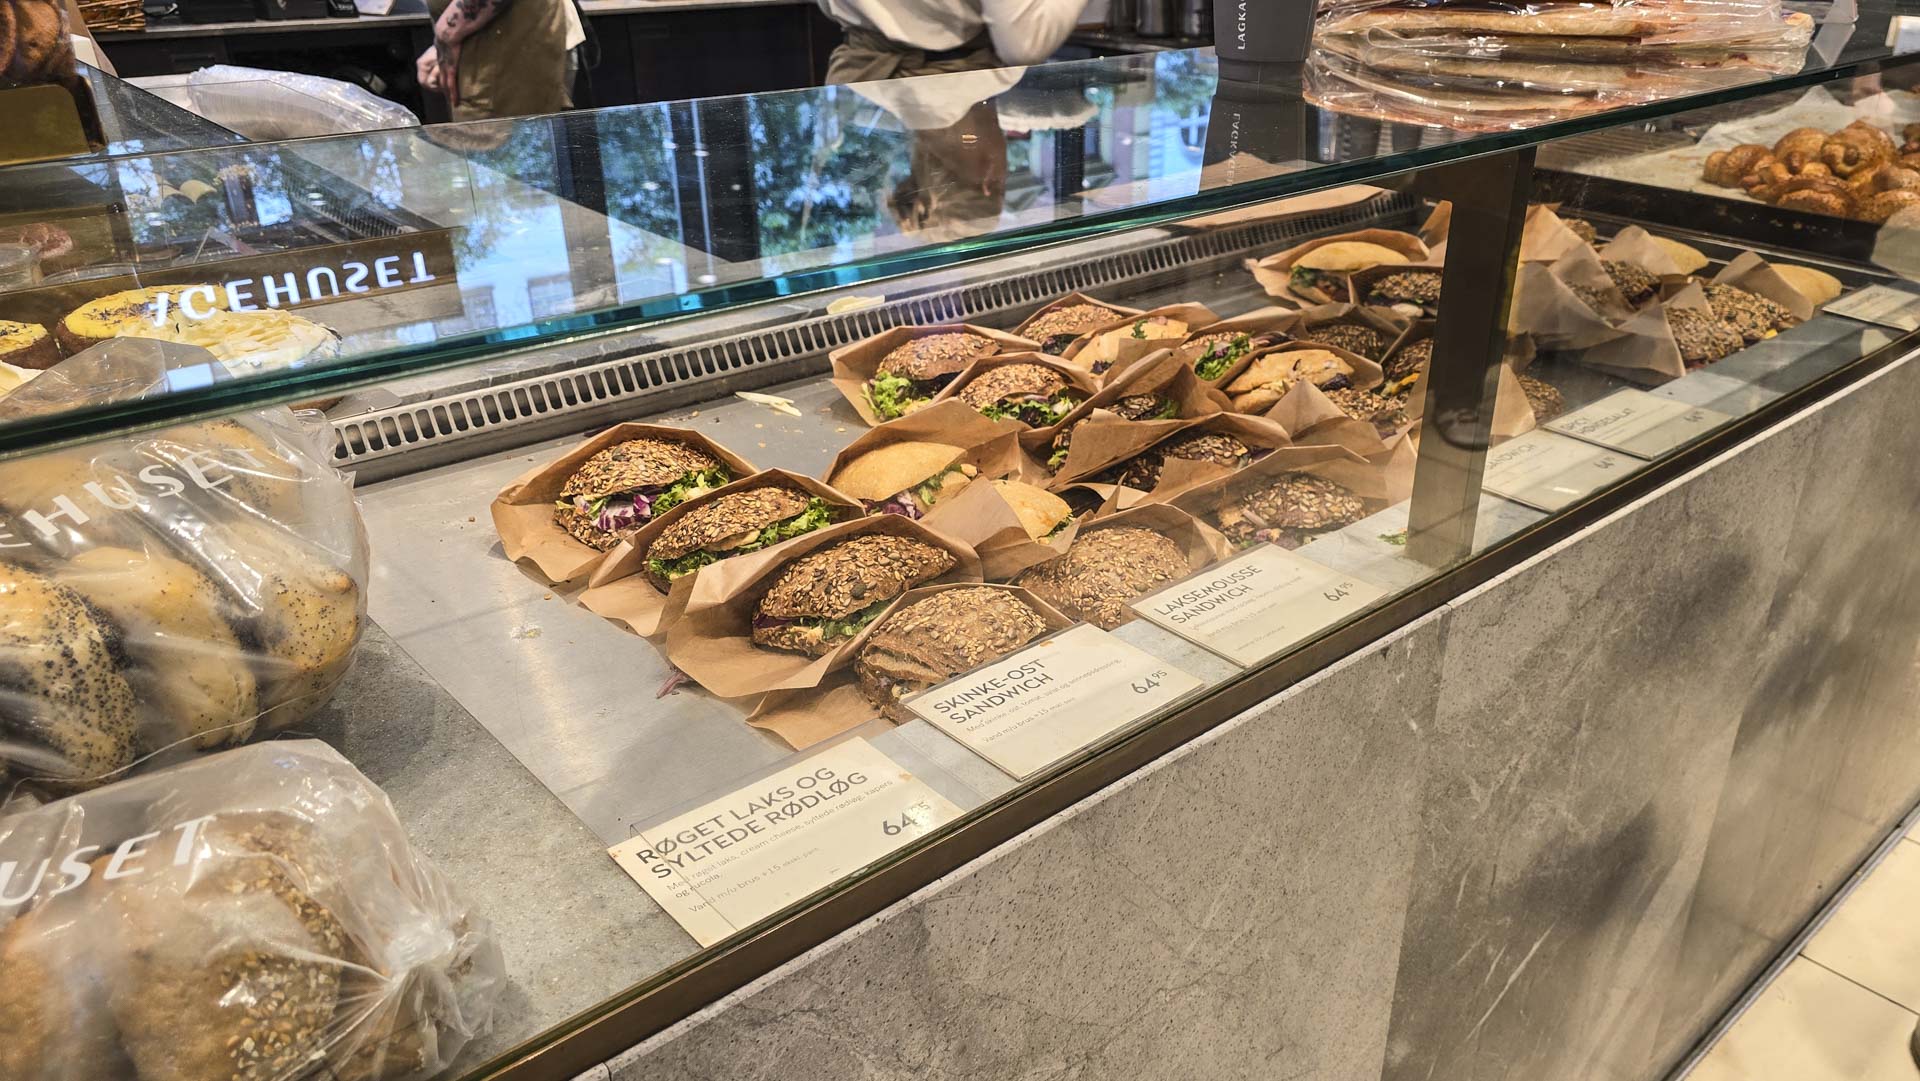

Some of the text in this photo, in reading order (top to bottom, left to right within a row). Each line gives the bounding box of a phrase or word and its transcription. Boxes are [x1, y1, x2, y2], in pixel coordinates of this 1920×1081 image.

[1237, 0, 1247, 50] LAGKA
[1154, 565, 1263, 616] LAKSEMOUSSE
[1171, 584, 1253, 624] SANDWICH
[934, 659, 1045, 713] SKINKE-OST
[949, 673, 1054, 724] SANDWICH
[635, 767, 836, 865] RØGET LAKS OG
[650, 771, 868, 879] SYLTEDE RØDLØG
[0, 815, 217, 906] USET
